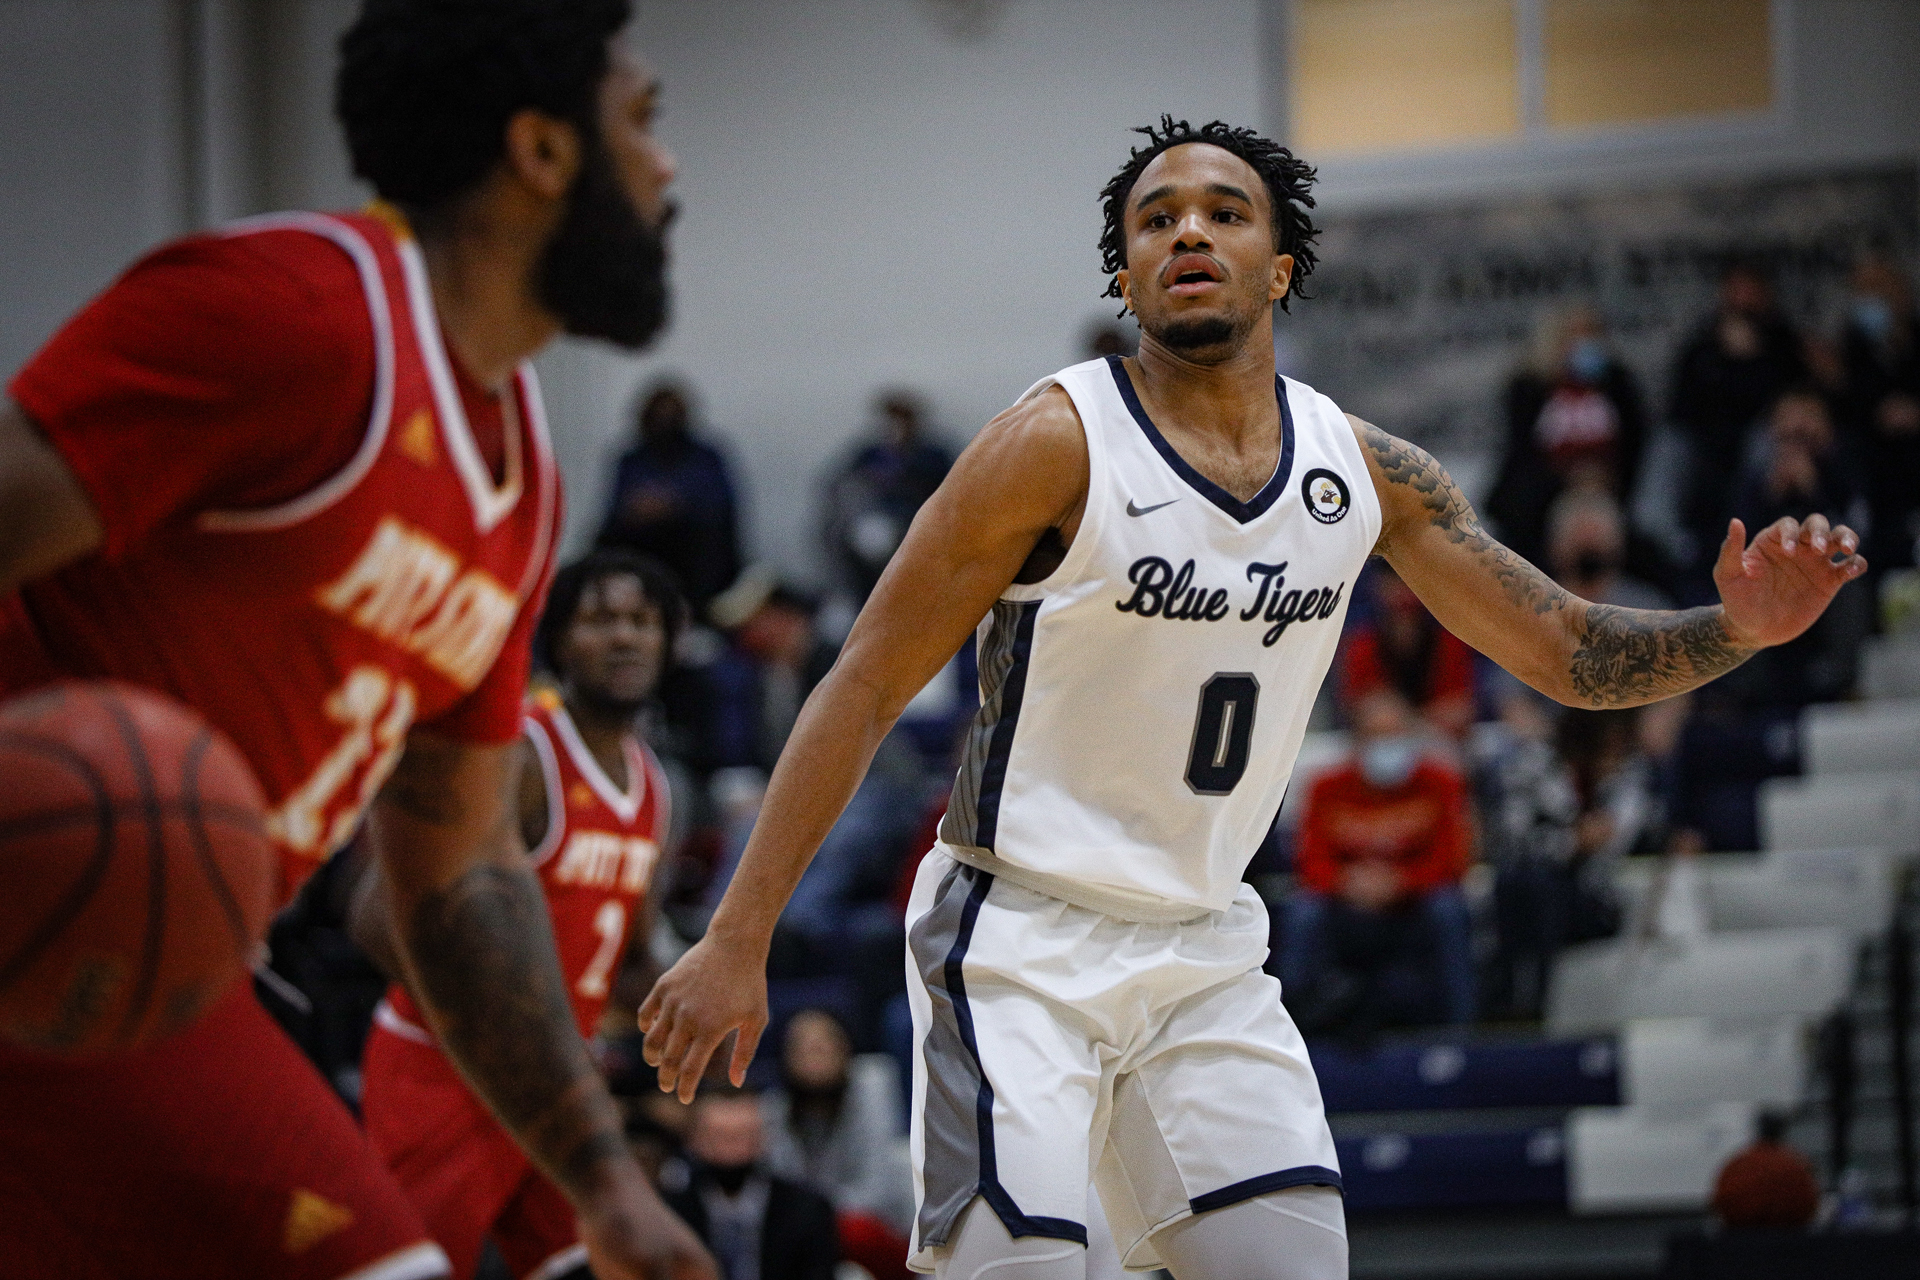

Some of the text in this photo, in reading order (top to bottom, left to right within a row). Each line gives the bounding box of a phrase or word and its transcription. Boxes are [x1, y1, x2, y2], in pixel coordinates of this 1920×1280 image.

[1311, 508, 1330, 522] United
[1336, 506, 1347, 518] One
[1115, 556, 1345, 648] Blue Tigers
[1183, 671, 1261, 796] 0
